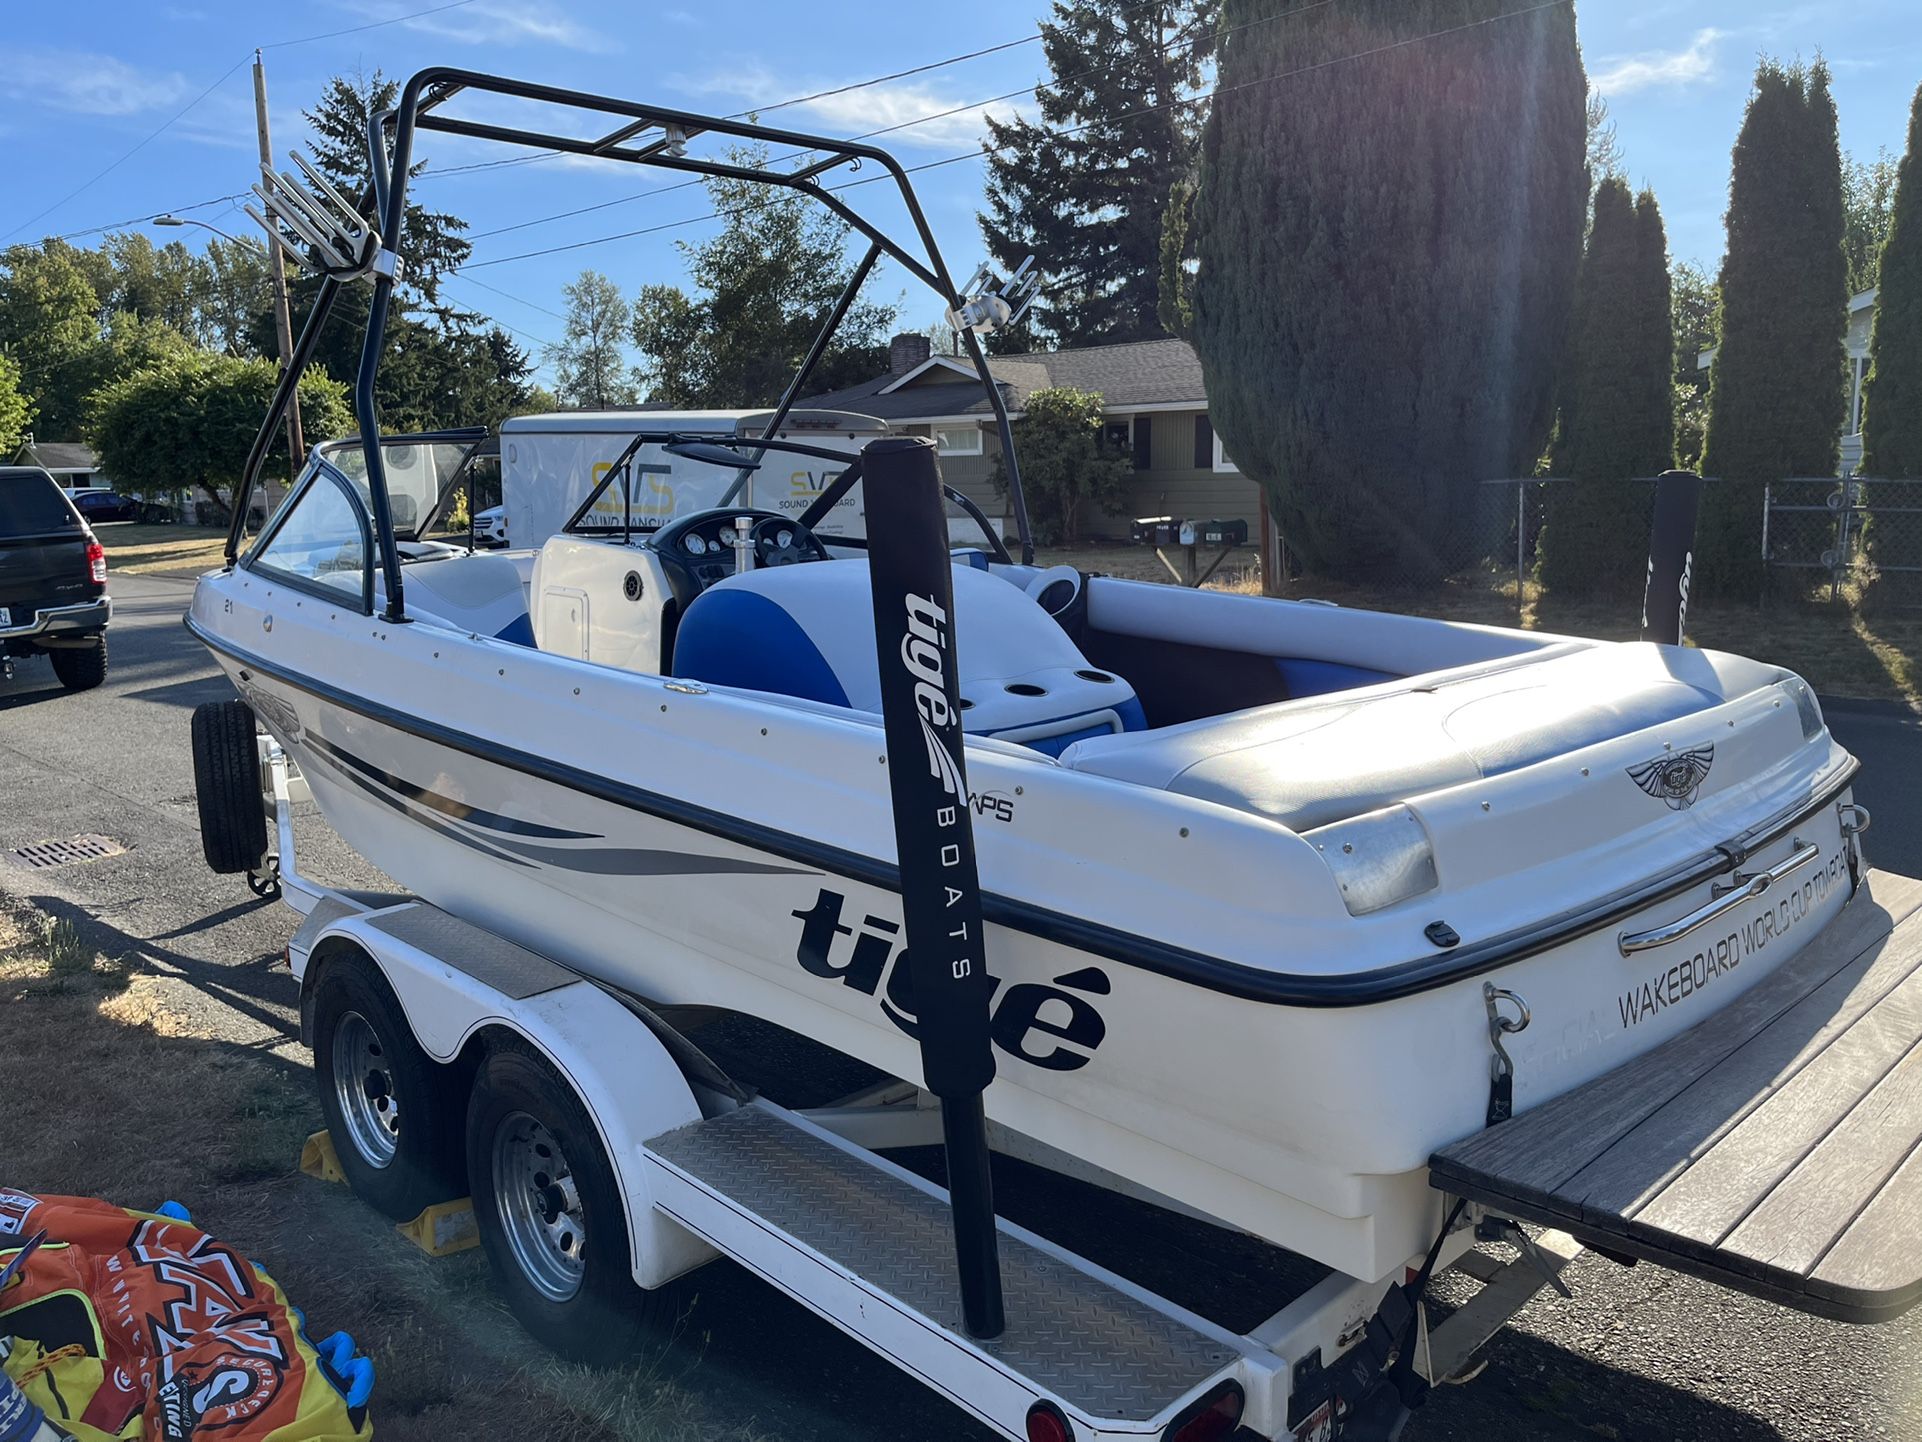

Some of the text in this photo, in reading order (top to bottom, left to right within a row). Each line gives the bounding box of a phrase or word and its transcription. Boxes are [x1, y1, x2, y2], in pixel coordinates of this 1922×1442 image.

[790, 472, 844, 496] SV
[779, 500, 808, 509] SOUND
[224, 598, 233, 615] 21
[936, 805, 971, 980] BOATS
[1618, 933, 1740, 1028] WAKEBOARD
[1742, 900, 1789, 955] WORLD
[1791, 882, 1812, 922] CUP
